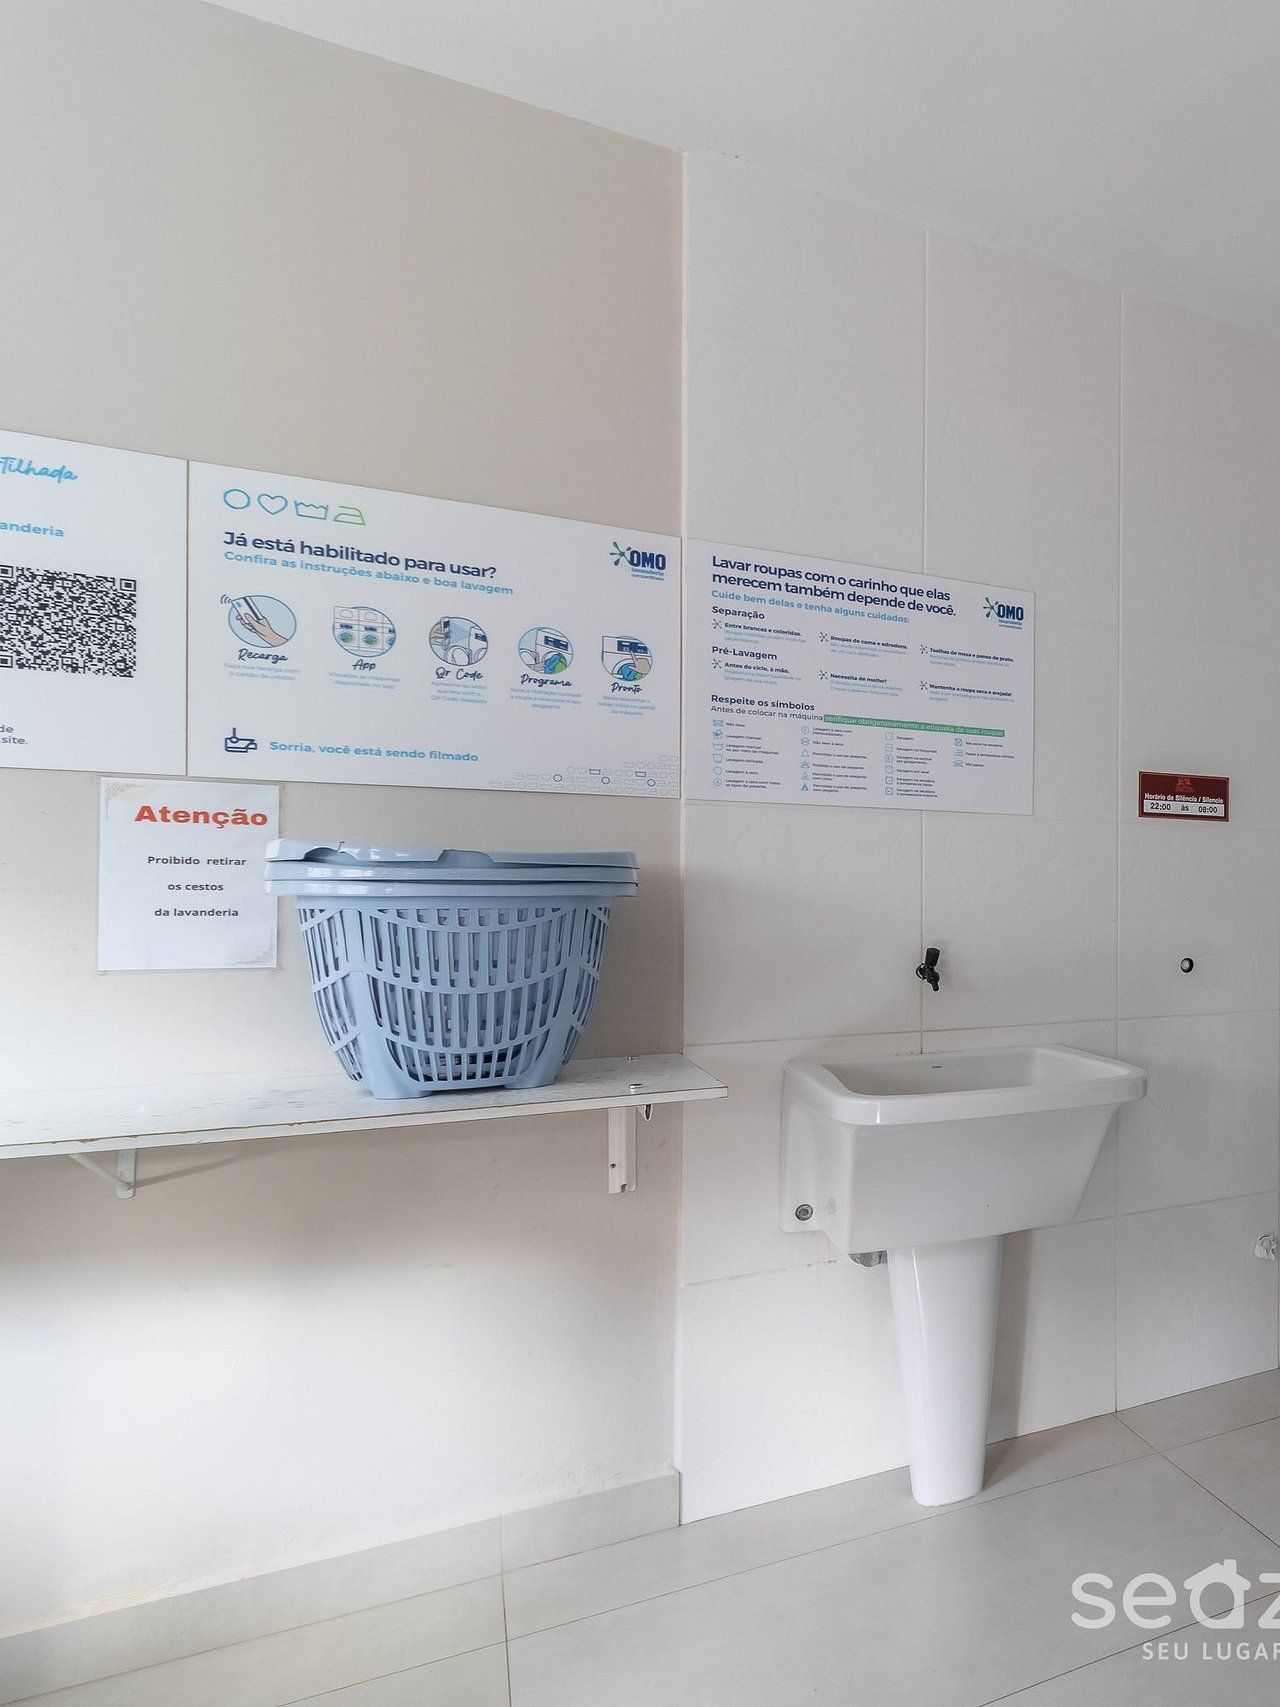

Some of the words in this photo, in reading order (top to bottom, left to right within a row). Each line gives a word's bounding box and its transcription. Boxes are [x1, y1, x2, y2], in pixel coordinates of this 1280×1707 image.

[223, 531, 248, 547] Já
[251, 538, 295, 554] está
[300, 541, 400, 566] habilitado
[404, 557, 446, 573] para
[450, 563, 496, 579] usar?
[629, 549, 667, 571] OMO
[224, 551, 277, 566] Confira
[281, 560, 297, 568] as
[300, 560, 372, 578] instruções
[376, 569, 420, 583] abaixo
[423, 577, 430, 585] e
[434, 577, 458, 588] boa
[461, 580, 514, 595] lavagem
[712, 555, 752, 572] Lavar
[753, 564, 802, 580] roupas
[804, 571, 836, 585] com
[837, 576, 847, 586] o
[848, 577, 898, 593] carinho
[899, 585, 924, 598] que
[926, 588, 951, 601] elas
[712, 573, 782, 592] merecem
[785, 583, 845, 601] também
[847, 590, 905, 609] depende
[907, 598, 923, 611] de
[926, 602, 956, 616] você.
[711, 589, 741, 601] Cuide
[743, 593, 766, 605] bem
[768, 596, 795, 608] delas
[796, 601, 803, 609] e
[804, 601, 832, 613] tenha
[834, 606, 865, 618] alguns
[711, 605, 765, 620] Separação
[997, 603, 1024, 621] OMO
[238, 648, 288, 664] Recarga
[711, 645, 778, 661] Pré-Lavagem
[352, 658, 377, 671] App
[435, 666, 451, 679] Qr
[455, 668, 484, 682] Code
[520, 673, 573, 688] Programa
[611, 681, 642, 693] Pronto
[710, 694, 756, 706] Respeite
[770, 699, 815, 711] símbolos
[710, 705, 734, 714] Antes
[735, 707, 746, 715] de
[748, 708, 775, 717] colocar
[789, 711, 823, 721] máquina
[1, 736, 28, 745] site.
[269, 741, 315, 753] Sorria,
[319, 745, 350, 755] você
[354, 746, 382, 757] está
[385, 748, 425, 759] sendo
[429, 750, 479, 762] filmado
[1150, 802, 1171, 810] 22:00
[134, 805, 268, 829] Atenção
[147, 856, 200, 865] Proibido
[206, 857, 247, 866] retirar
[167, 883, 182, 891] os
[185, 883, 224, 891] cestos
[154, 908, 170, 917] da
[173, 908, 239, 917] lavanderia
